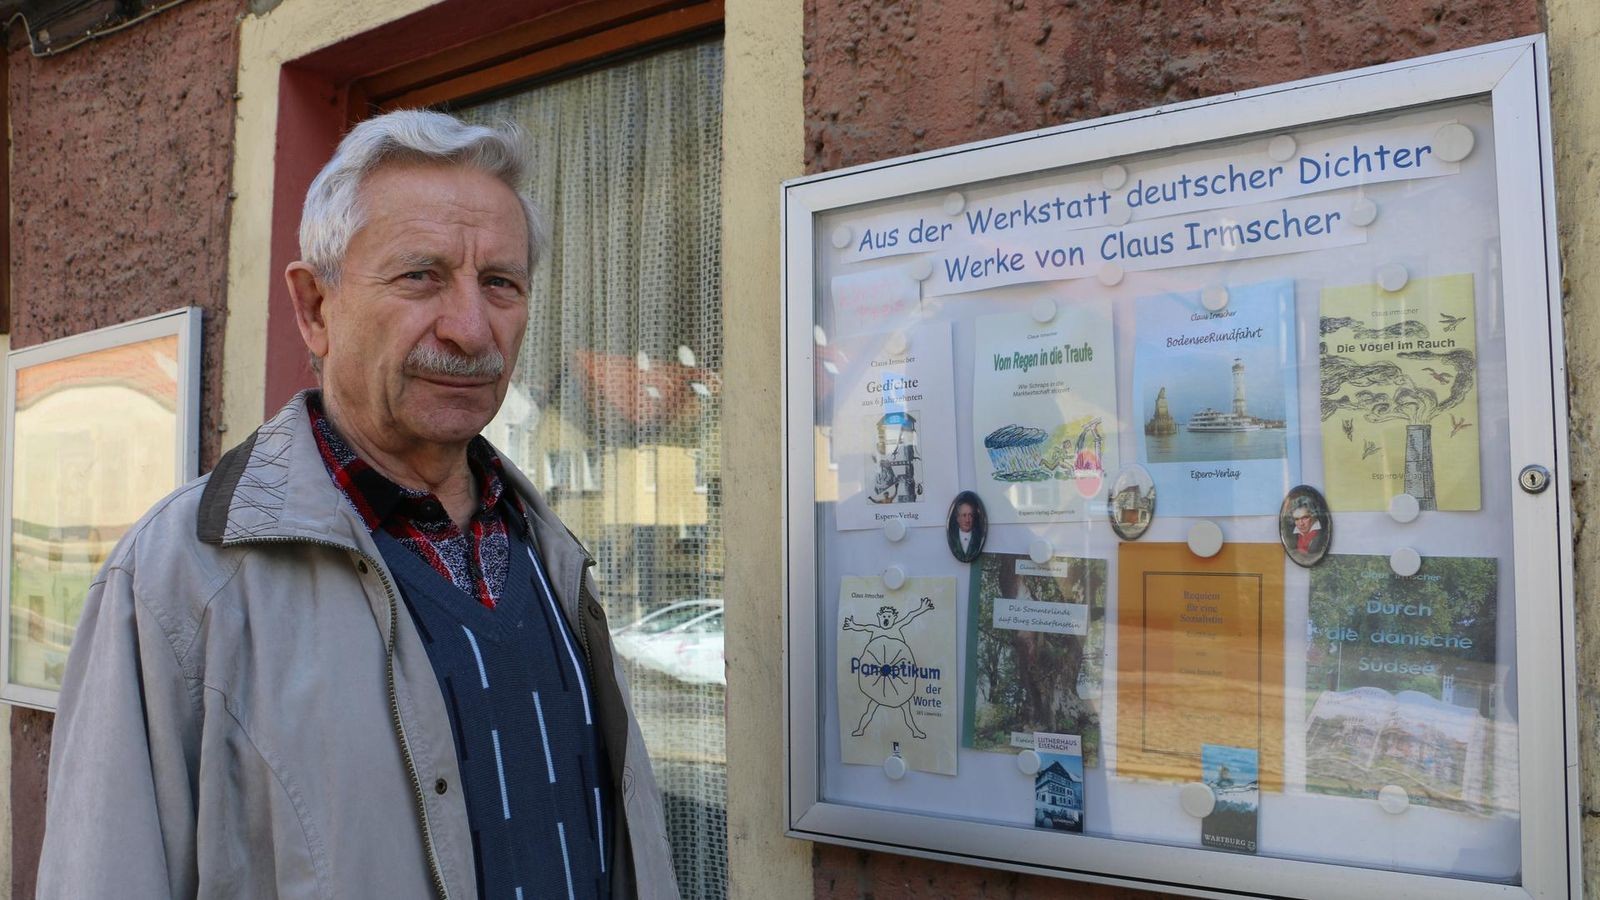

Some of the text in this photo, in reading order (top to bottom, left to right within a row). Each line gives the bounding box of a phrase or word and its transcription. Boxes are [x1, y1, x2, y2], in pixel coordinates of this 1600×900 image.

[858, 144, 1432, 252] Aus der Werkstatt deutscher Dichter
[944, 208, 1342, 282] Werke von Claus Irmscher
[1190, 313, 1208, 321] Claus
[1166, 327, 1263, 348] BodenseeRundfahrt
[1337, 344, 1356, 354] Die
[1397, 340, 1413, 350] im
[1417, 338, 1456, 349] Rauch
[993, 342, 1093, 373] Vom Regen in die Traufe
[866, 378, 919, 394] Gedichte
[1190, 468, 1241, 480] Espero-Verlag
[1367, 600, 1433, 617] Durch
[1327, 626, 1359, 641] die
[851, 657, 941, 681] Panoptikum
[925, 684, 942, 695] der
[913, 696, 942, 708] Worte
[1037, 737, 1078, 747] LUTHERHAUS
[1038, 742, 1069, 751] EISENACH
[1204, 833, 1246, 847] WARTBURG
